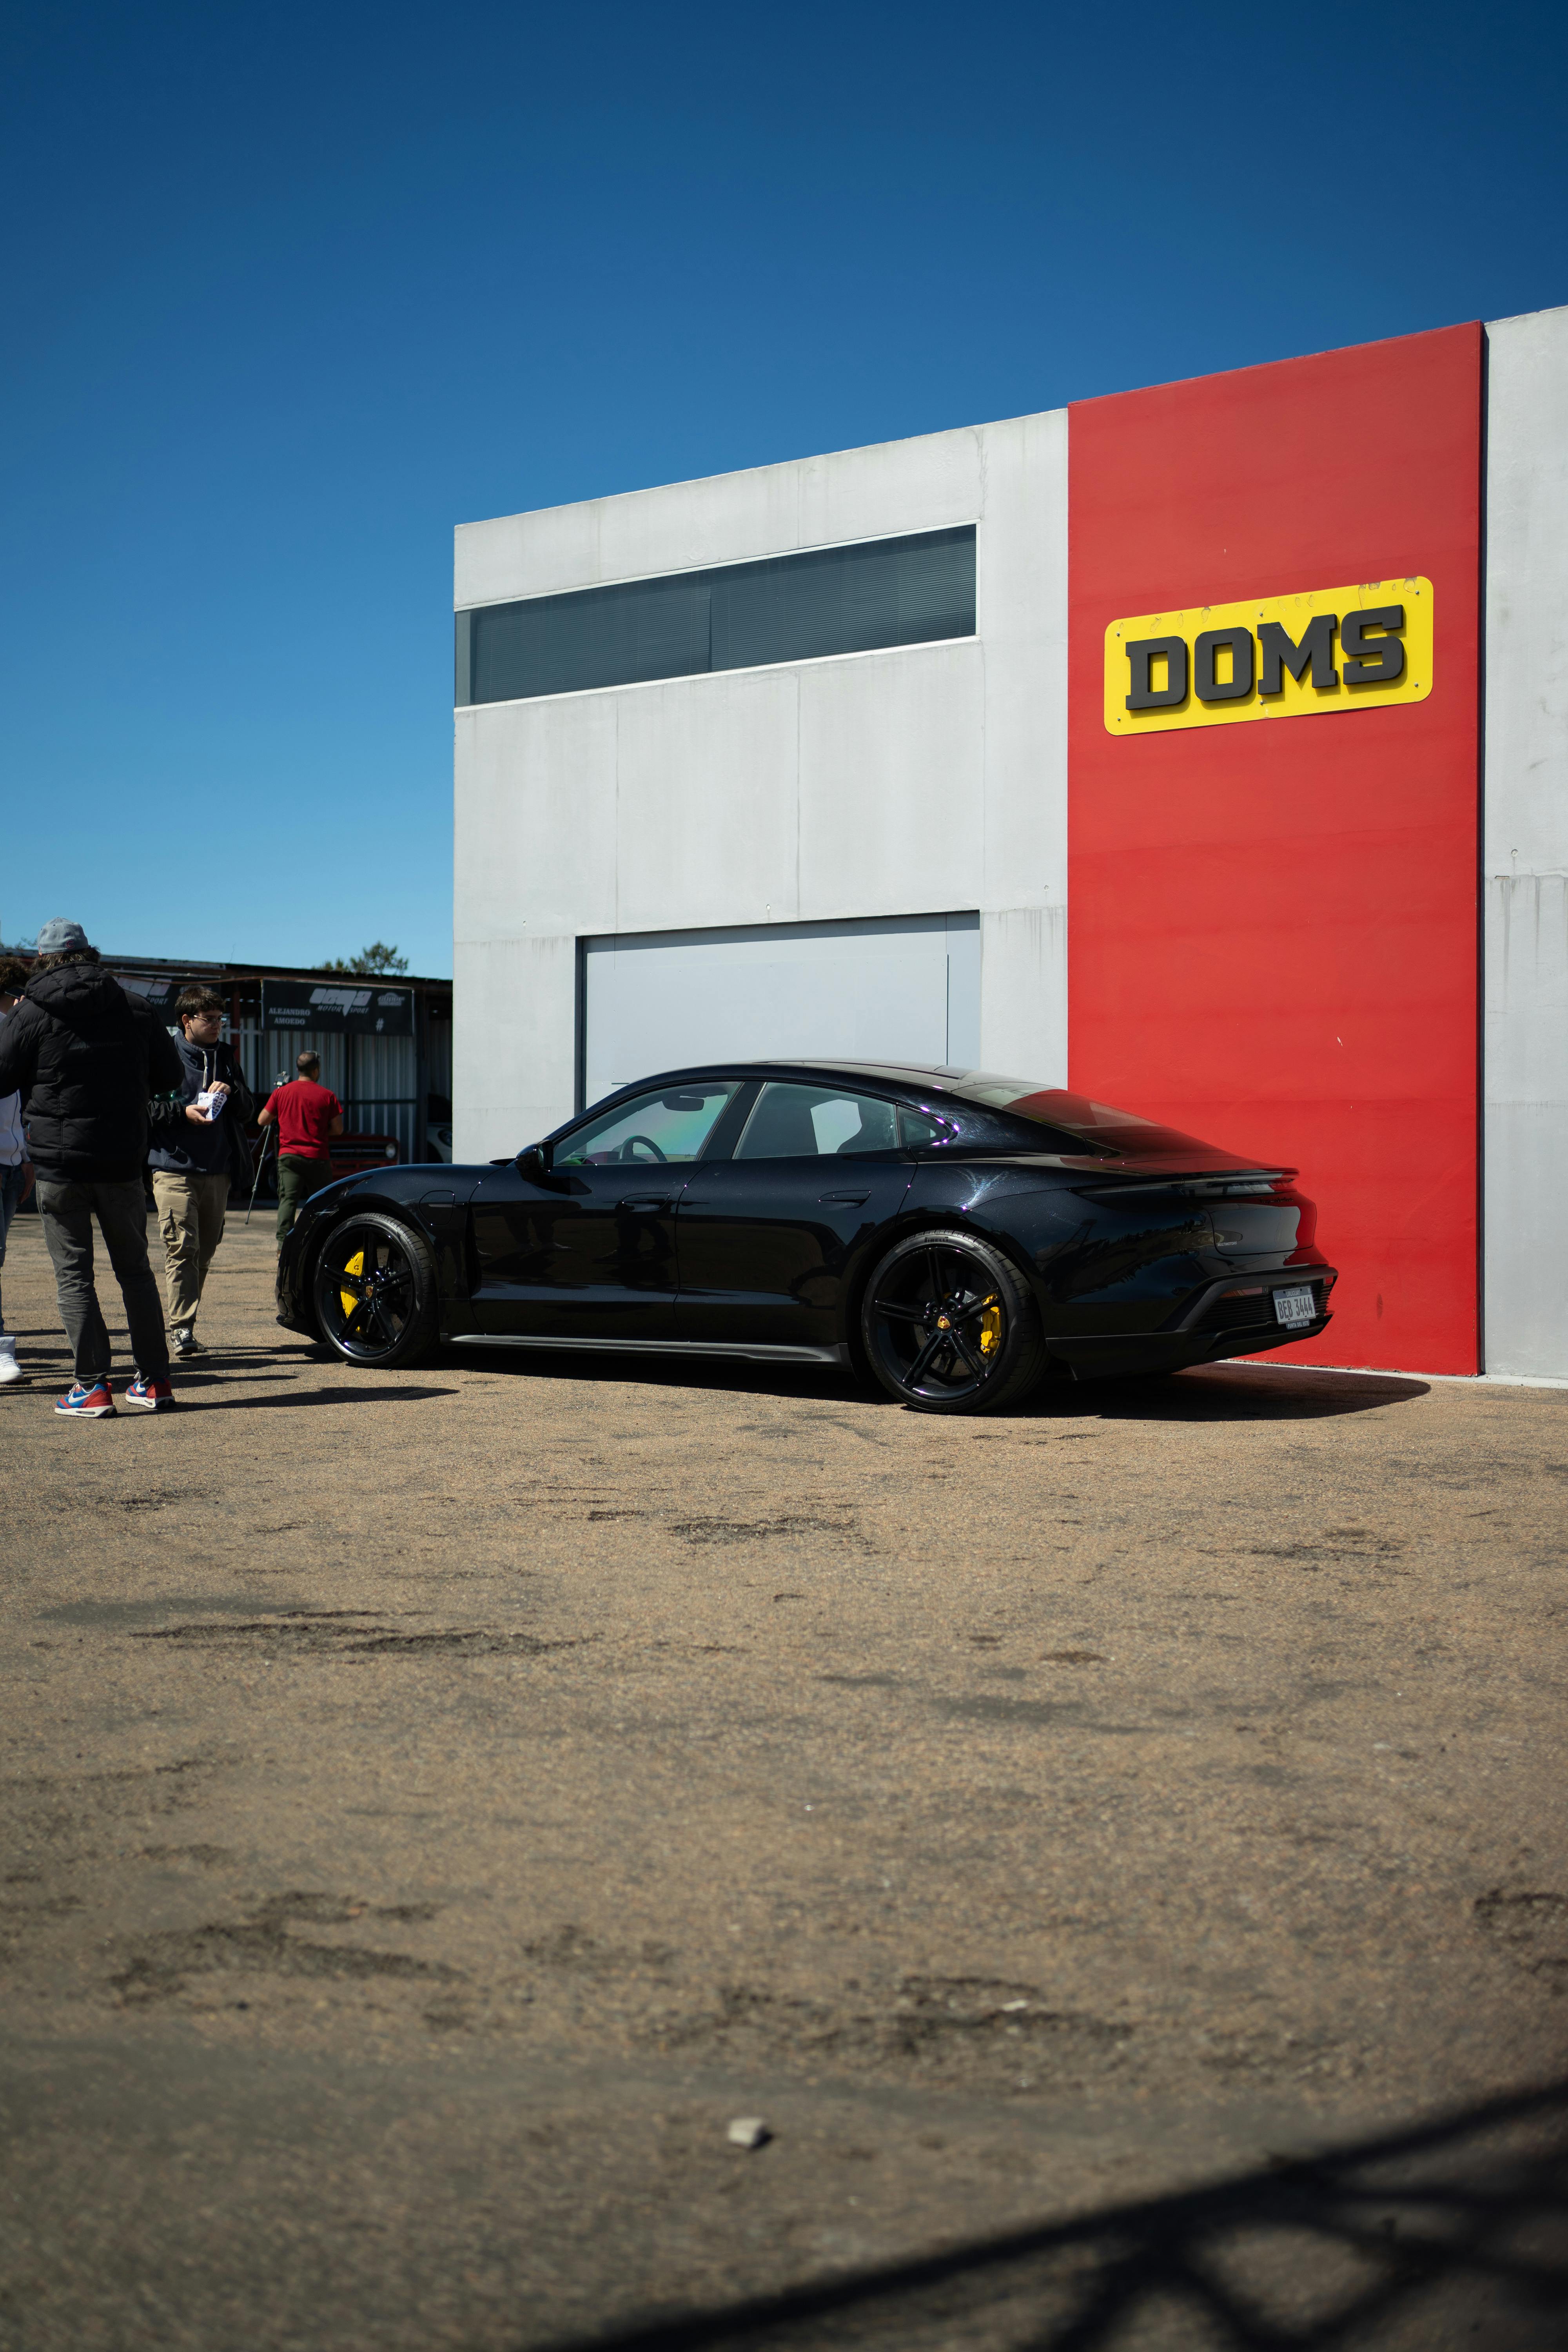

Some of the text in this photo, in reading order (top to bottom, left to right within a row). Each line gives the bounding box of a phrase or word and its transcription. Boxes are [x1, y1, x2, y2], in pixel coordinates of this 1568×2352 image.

[1125, 604, 1404, 710] DOMS
[66, 940, 75, 949] C
[269, 1007, 310, 1016] ALEJANDRO
[1278, 1297, 1313, 1319] BEB 3444
